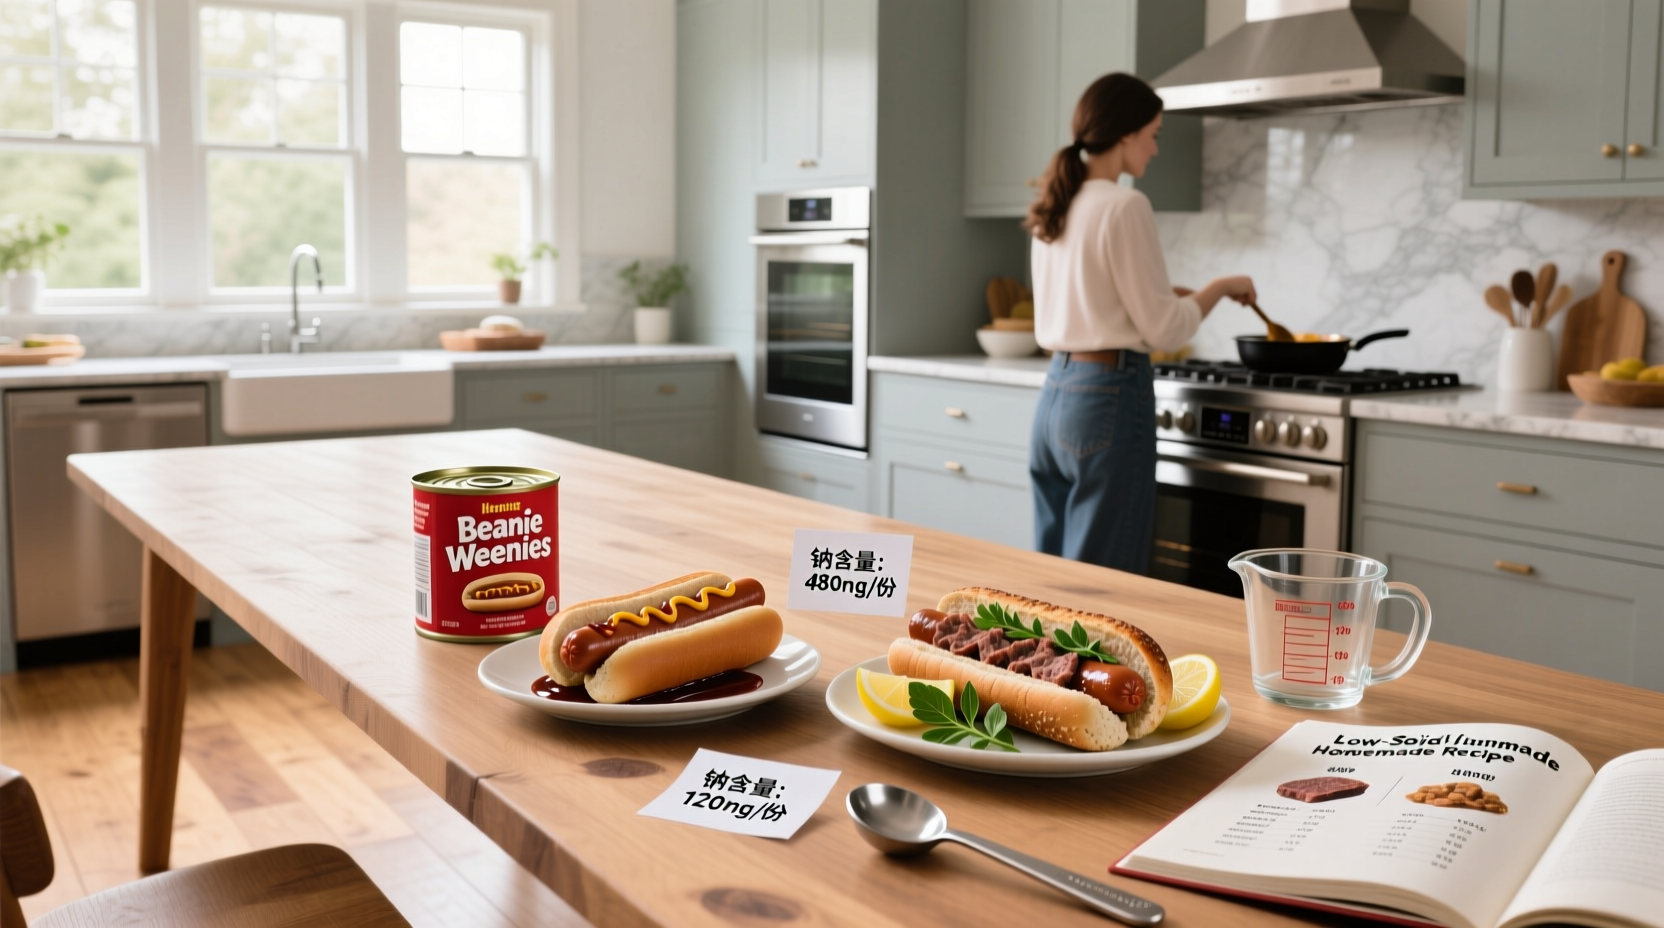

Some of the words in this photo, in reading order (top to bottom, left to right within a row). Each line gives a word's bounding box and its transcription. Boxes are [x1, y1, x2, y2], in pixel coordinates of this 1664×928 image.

[457, 508, 543, 543] Beanie
[445, 535, 552, 573] Weenies
[1442, 746, 1515, 763] Recipe
